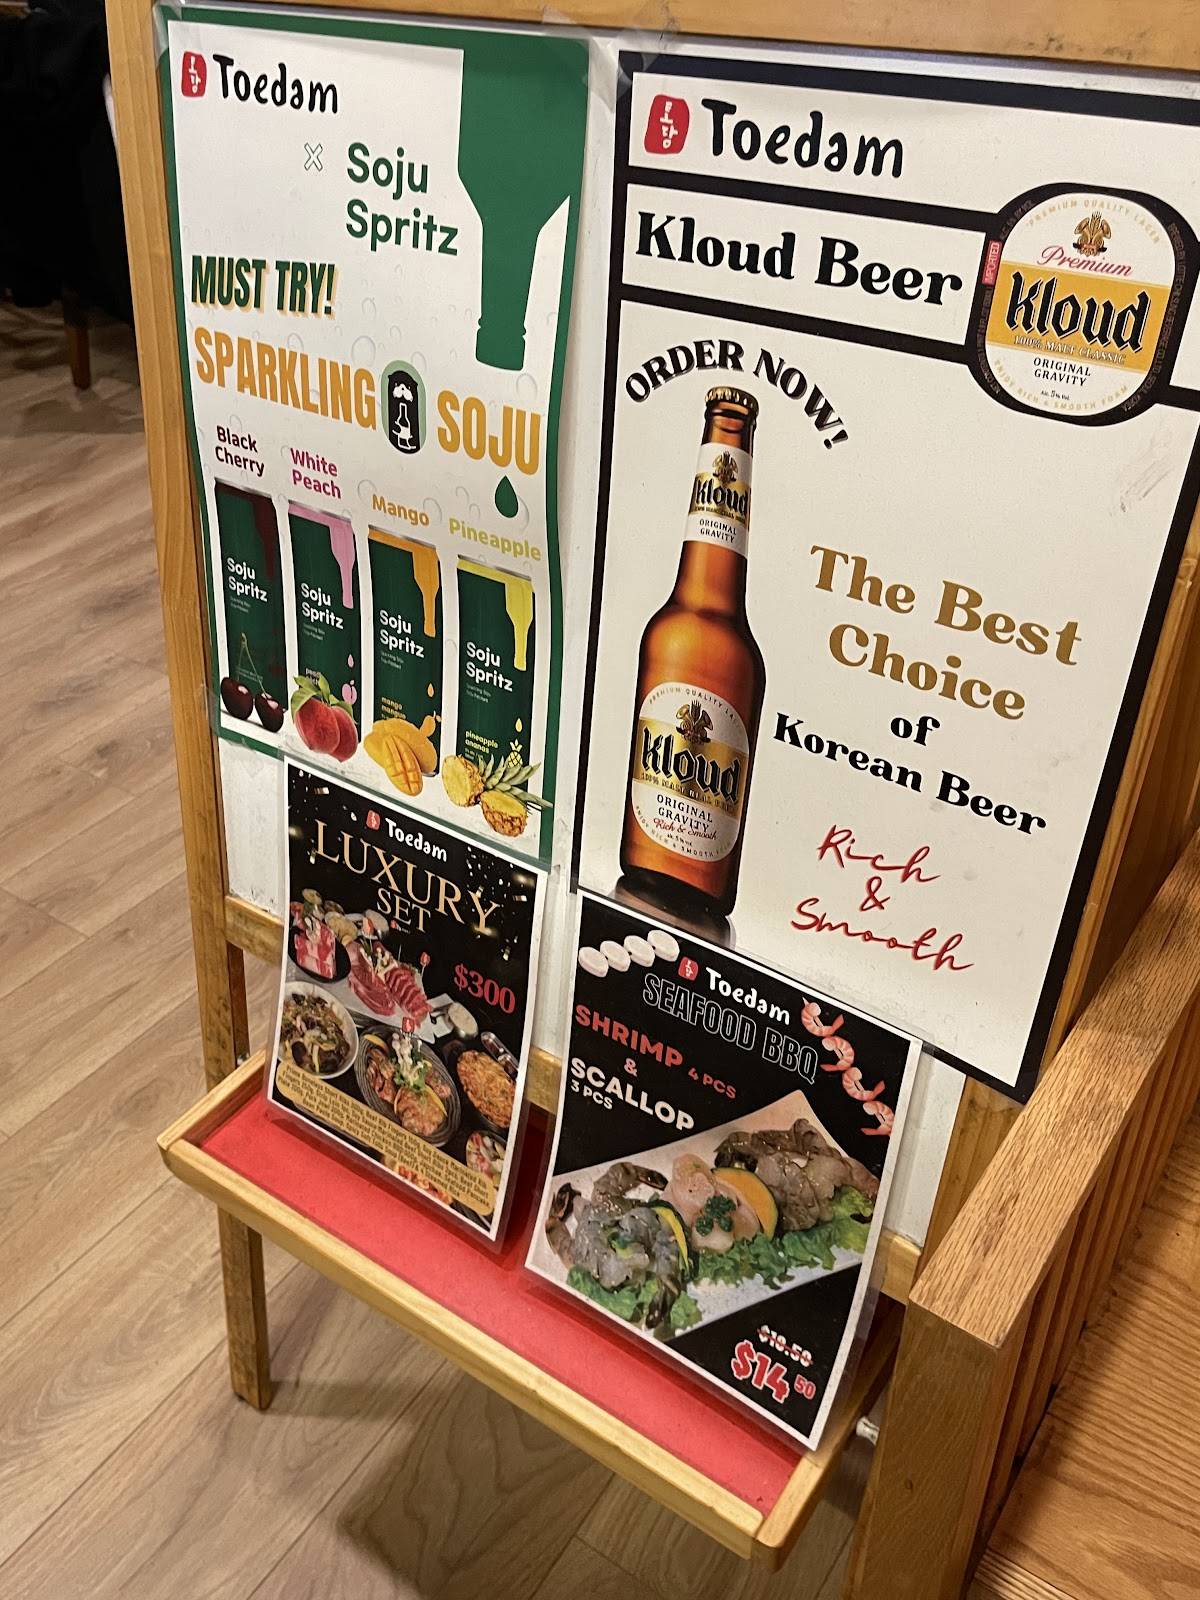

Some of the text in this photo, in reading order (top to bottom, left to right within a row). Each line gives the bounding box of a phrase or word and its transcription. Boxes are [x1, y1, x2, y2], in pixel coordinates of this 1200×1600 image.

[213, 54, 338, 114] Toedam
[701, 98, 904, 179] Toedam
[347, 142, 428, 200] Soju
[346, 199, 458, 256] Spritz
[636, 211, 964, 307] Kloud Beer
[1037, 245, 1133, 277] Premium
[191, 255, 338, 318] MUST TRY!
[1005, 271, 1152, 353] Kloud
[1033, 357, 1091, 377] ORIGINAL
[1034, 369, 1088, 386] GRAVITY
[194, 327, 541, 476] SPARKLING SOJU
[624, 339, 850, 451] ORDER NOW!
[216, 425, 258, 453] Black
[215, 446, 265, 477] Cherry
[290, 448, 338, 477] White
[292, 469, 341, 499] Peach
[372, 494, 429, 527] Mango
[699, 518, 737, 536] ORIGINAL
[449, 518, 541, 561] Pineapple
[700, 528, 735, 543] GRAVITY
[227, 557, 256, 580] Soju
[228, 576, 268, 602] Spritz
[300, 582, 331, 607] Soju
[810, 544, 1084, 667] The Best
[301, 602, 344, 629] Spritz
[379, 609, 412, 634] Soju
[379, 629, 424, 658] Spritz
[466, 641, 500, 667] Soju
[465, 661, 513, 692] Spritz
[828, 623, 1026, 721] Choice
[465, 731, 499, 748] pineapple
[891, 714, 941, 747] of
[641, 727, 741, 802] Kloud
[774, 712, 1047, 836] Korean Beer
[654, 818, 675, 832] Rich
[656, 794, 713, 823] ORIGINAL
[658, 807, 709, 833] GRAVITY
[385, 817, 447, 862] Toedam
[817, 824, 941, 884] Rich
[314, 818, 501, 937] LUXURY
[858, 876, 891, 912] &
[377, 887, 431, 933] SET
[791, 897, 975, 971] Smooth
[453, 963, 516, 1014] $300
[706, 968, 791, 1025] Toedam
[642, 973, 819, 1084] SEAFOOD BBQ
[574, 1004, 737, 1100] SHRIMP 4 PCS
[623, 1056, 638, 1077] &
[571, 1057, 695, 1132] SCALLOP
[571, 1081, 613, 1111] 3 PCS
[731, 1339, 816, 1404] $14 50
